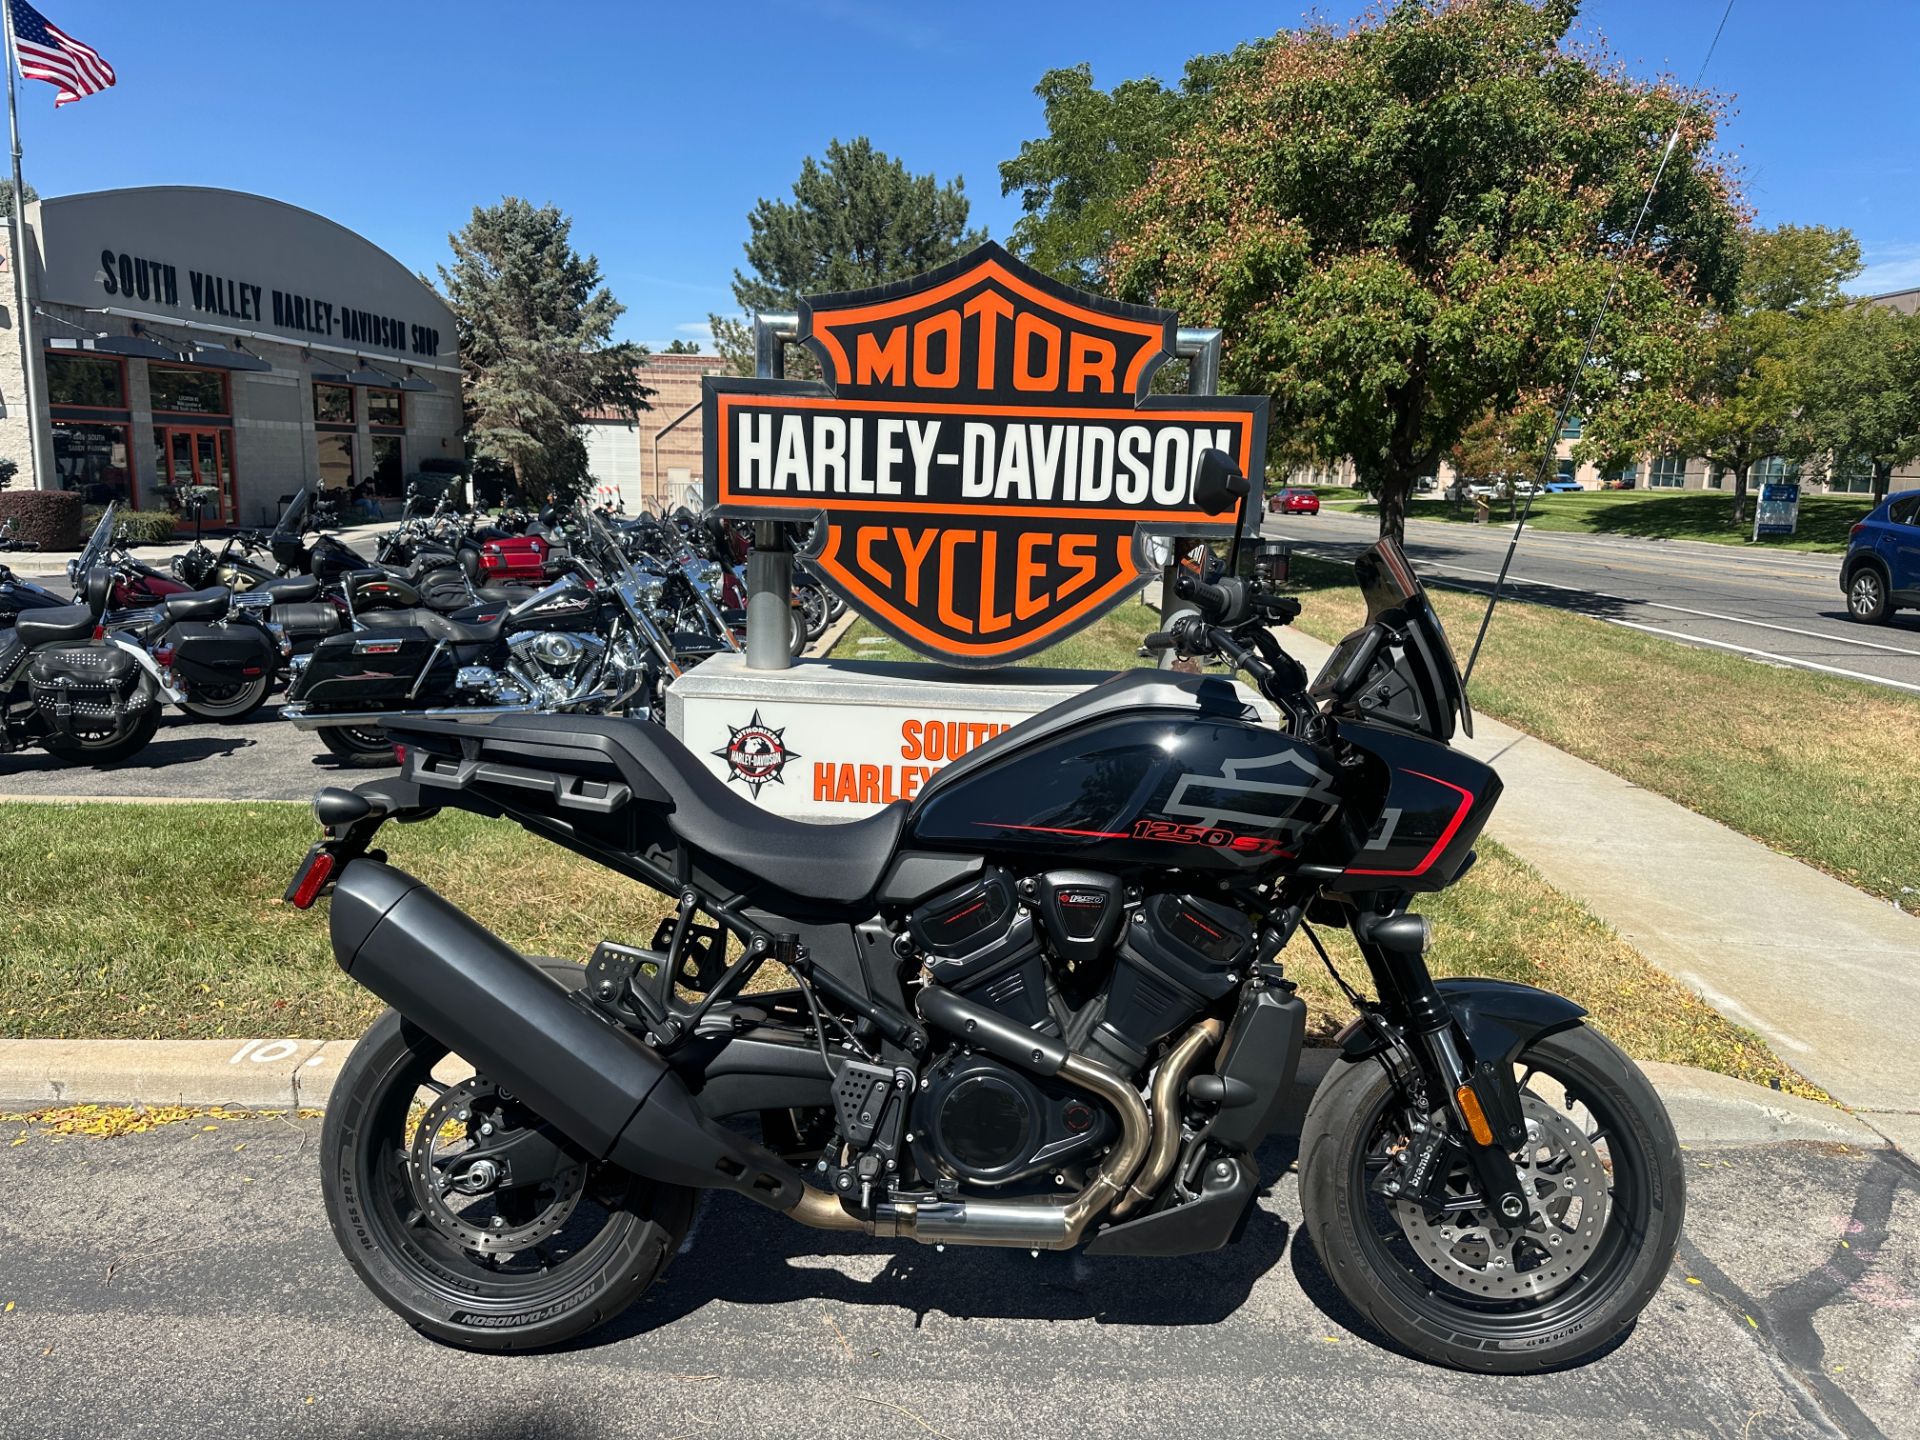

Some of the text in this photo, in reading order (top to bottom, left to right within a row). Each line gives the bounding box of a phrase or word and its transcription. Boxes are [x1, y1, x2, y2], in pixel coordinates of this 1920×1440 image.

[101, 249, 439, 358] SOUTH VALLEY HARLEY-DAVIDSON SHOP
[856, 288, 1117, 393] MOTOR
[856, 526, 1098, 635] CYCLES
[732, 726, 781, 745] AUTHORIZED
[901, 719, 1011, 762] SOUT
[730, 750, 782, 767] HARLEY-DAVIDSON
[733, 768, 778, 783] RENTALS
[1409, 1145, 1433, 1187] brembo
[342, 1167, 373, 1250] 180/55 ZR 17
[461, 1283, 596, 1327] HARLEY-DAVIDSON
